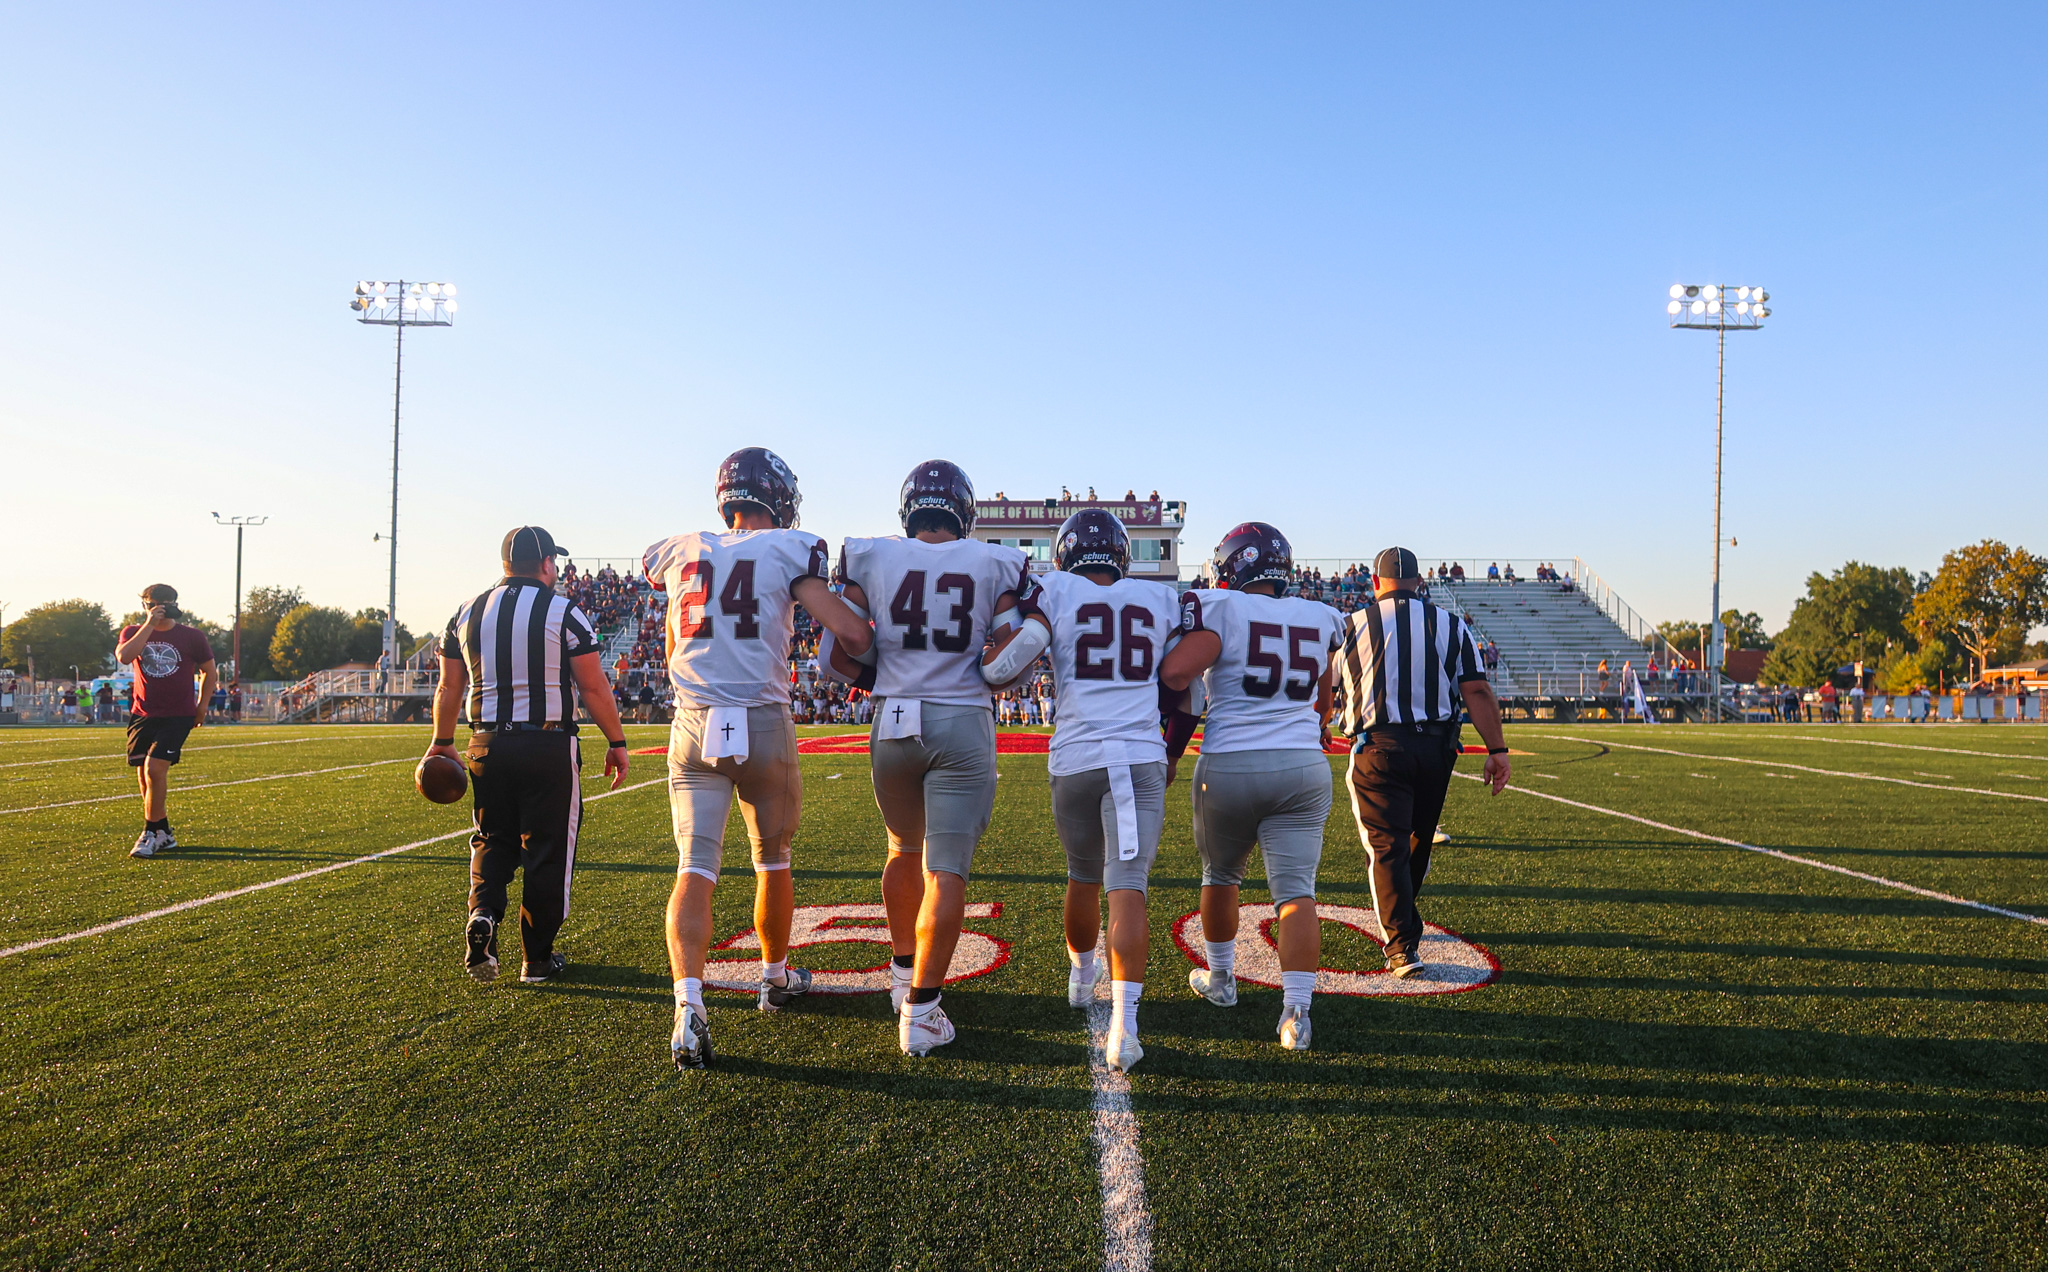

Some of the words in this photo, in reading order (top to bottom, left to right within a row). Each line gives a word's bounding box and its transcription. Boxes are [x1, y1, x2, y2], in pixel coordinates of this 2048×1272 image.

[730, 462, 739, 470] 24
[918, 496, 947, 505] schutt
[976, 506, 1006, 519] HOME
[1007, 506, 1022, 519] OF
[1024, 506, 1046, 519] THE
[1082, 552, 1110, 560] schutt
[680, 558, 760, 640] 24
[889, 569, 977, 653] 43
[1074, 602, 1156, 682] 26
[1241, 620, 1322, 702] 55
